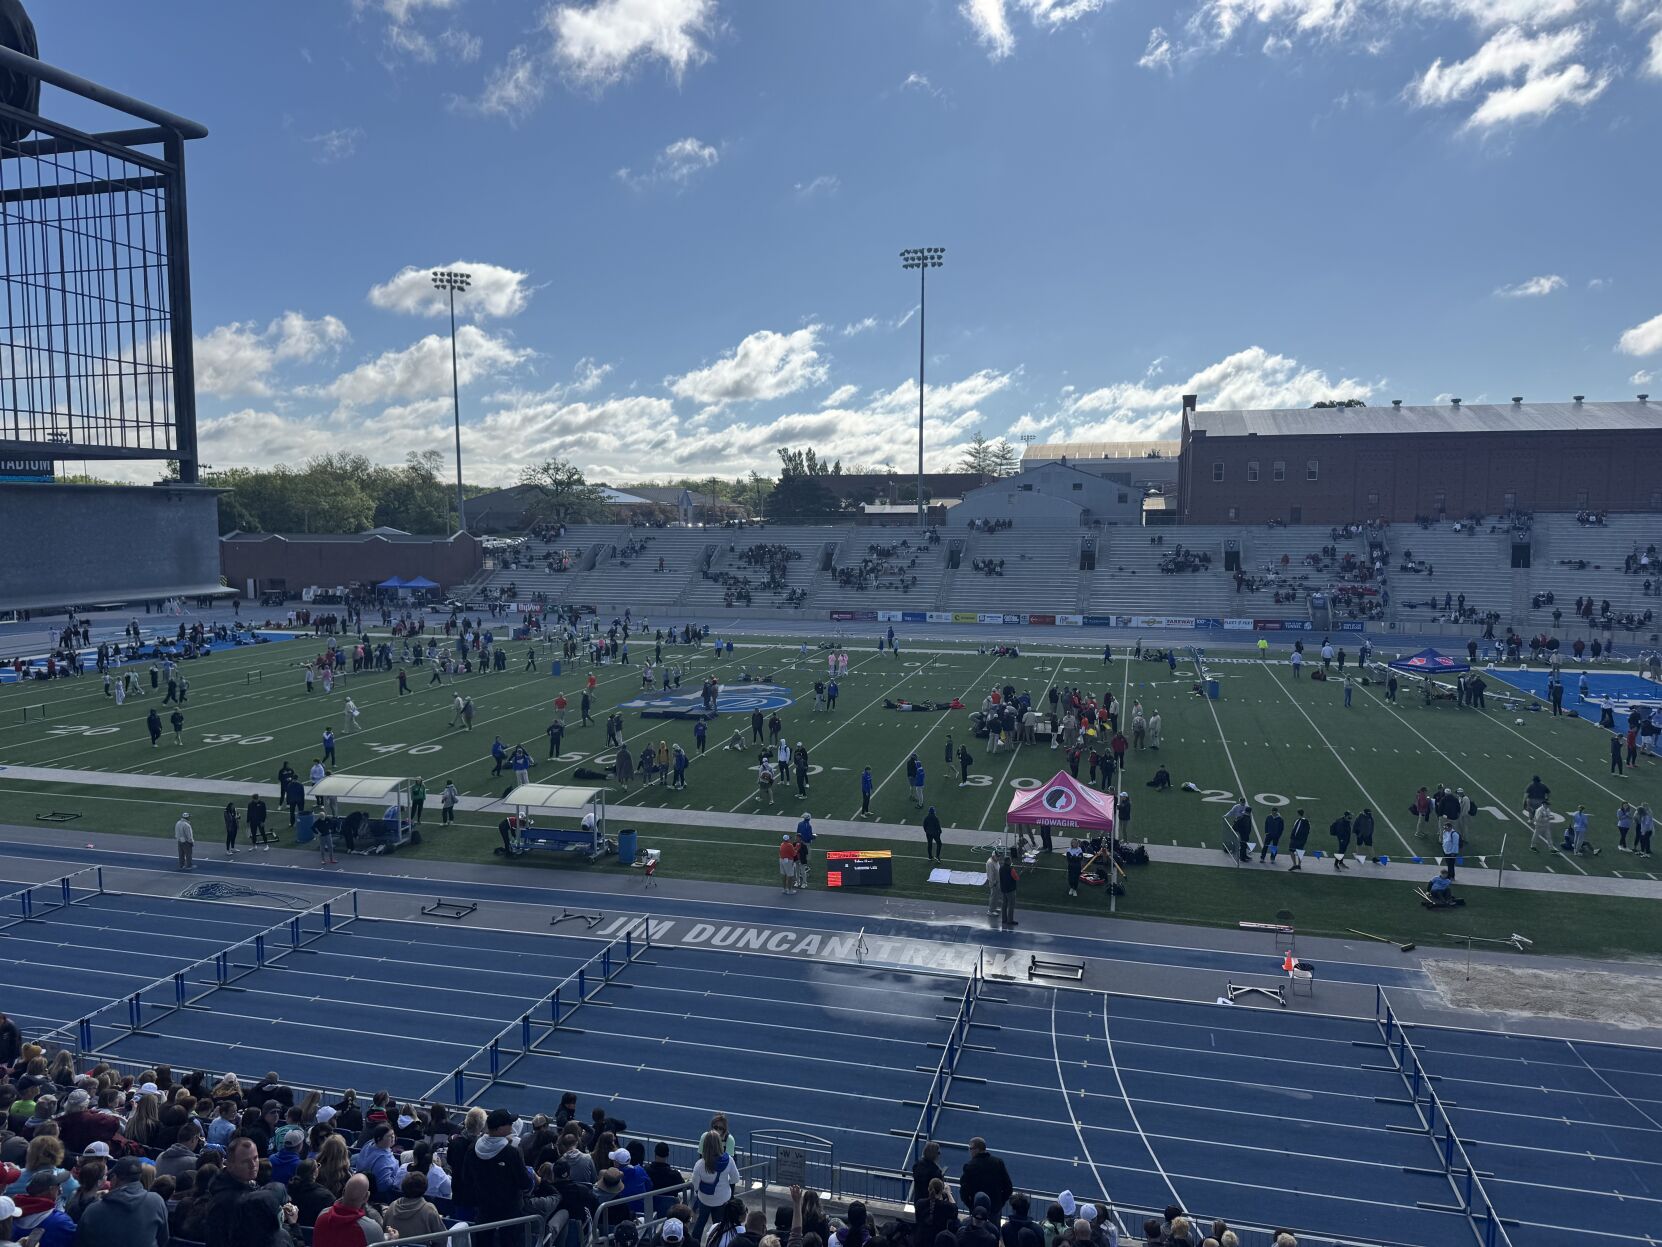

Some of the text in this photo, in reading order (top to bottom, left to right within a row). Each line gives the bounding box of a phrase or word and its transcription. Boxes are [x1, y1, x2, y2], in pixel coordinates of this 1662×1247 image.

[1200, 789, 1291, 807] 20
[596, 916, 676, 940] JIM
[680, 922, 856, 960] DUNCAN
